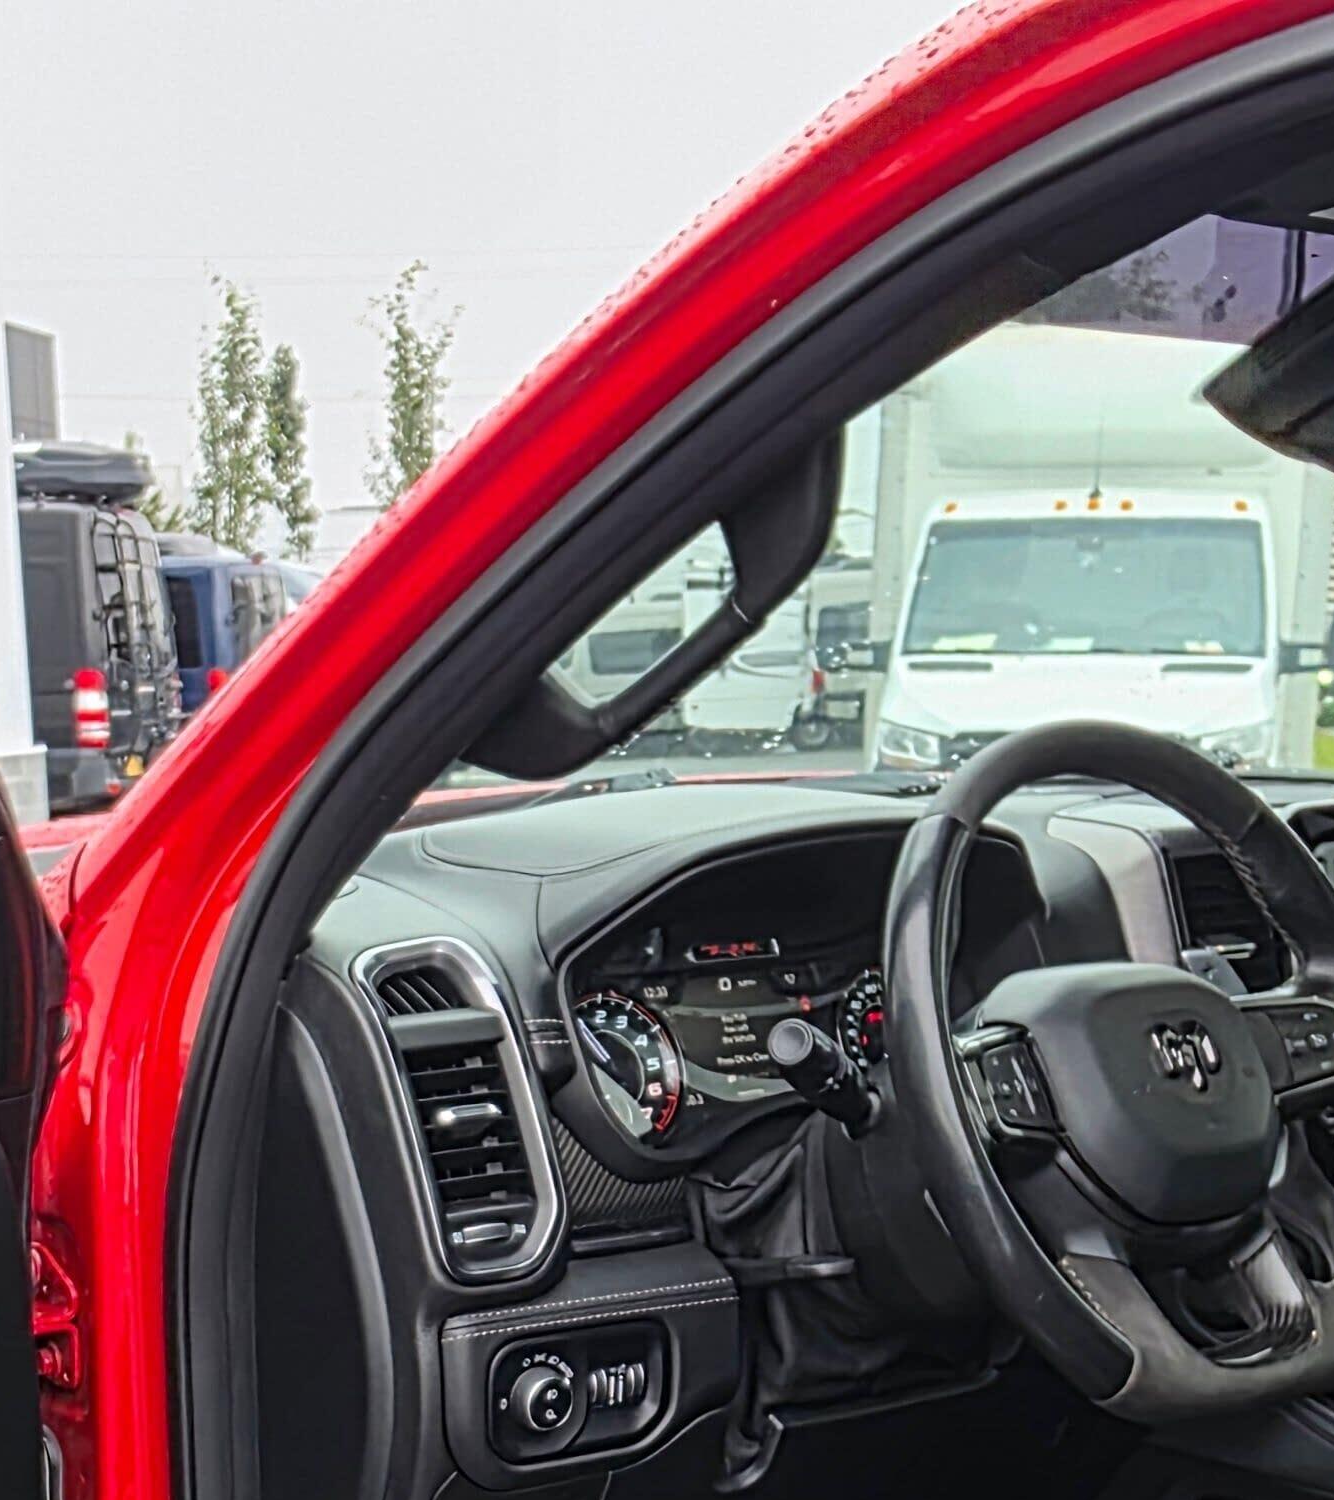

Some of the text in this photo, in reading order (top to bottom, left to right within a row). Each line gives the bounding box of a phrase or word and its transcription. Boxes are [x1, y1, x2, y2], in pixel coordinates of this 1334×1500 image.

[595, 1010, 607, 1023] 2
[615, 1015, 628, 1029] 3
[634, 1034, 648, 1047] 4
[646, 1057, 660, 1071] 5
[648, 1082, 662, 1096] 6
